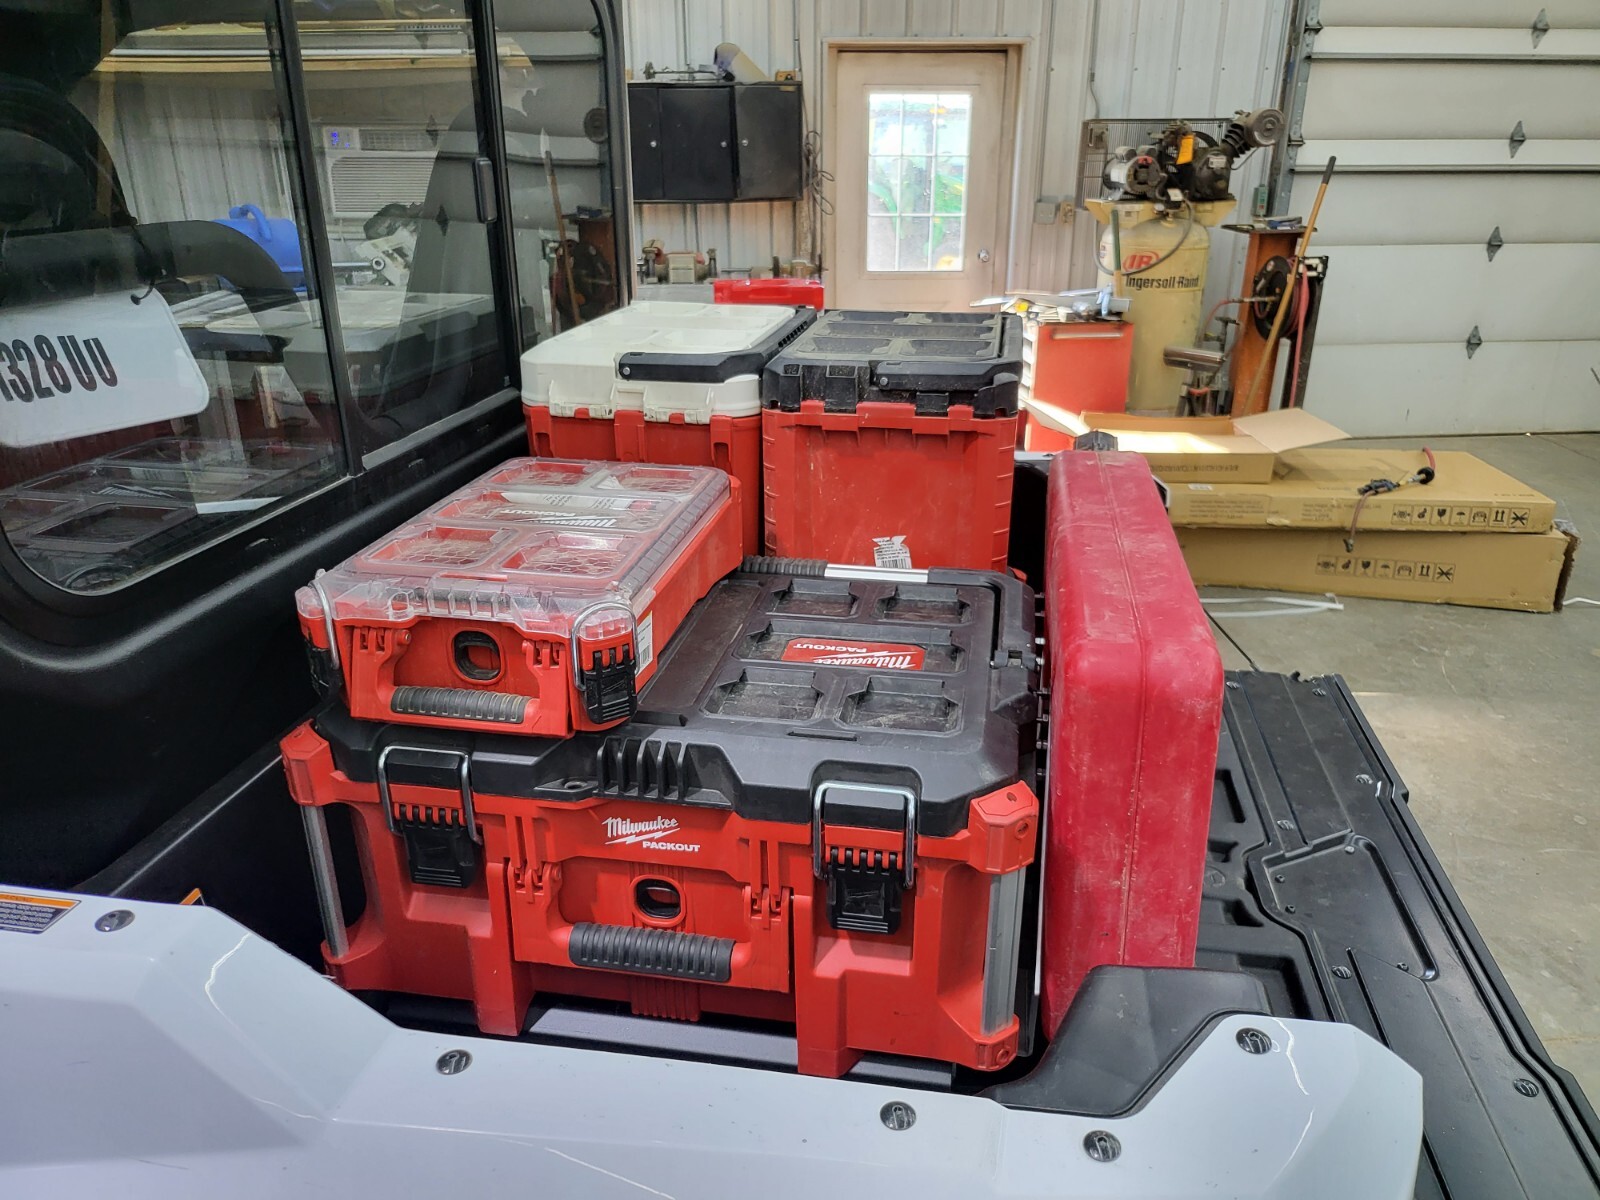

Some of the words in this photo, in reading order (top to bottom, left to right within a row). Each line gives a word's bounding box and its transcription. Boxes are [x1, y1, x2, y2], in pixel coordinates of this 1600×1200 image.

[793, 643, 867, 653] PACKOUT
[815, 655, 916, 669] Milwaukee
[601, 816, 679, 838] Milwaukee
[642, 841, 701, 852] PACKOUT
